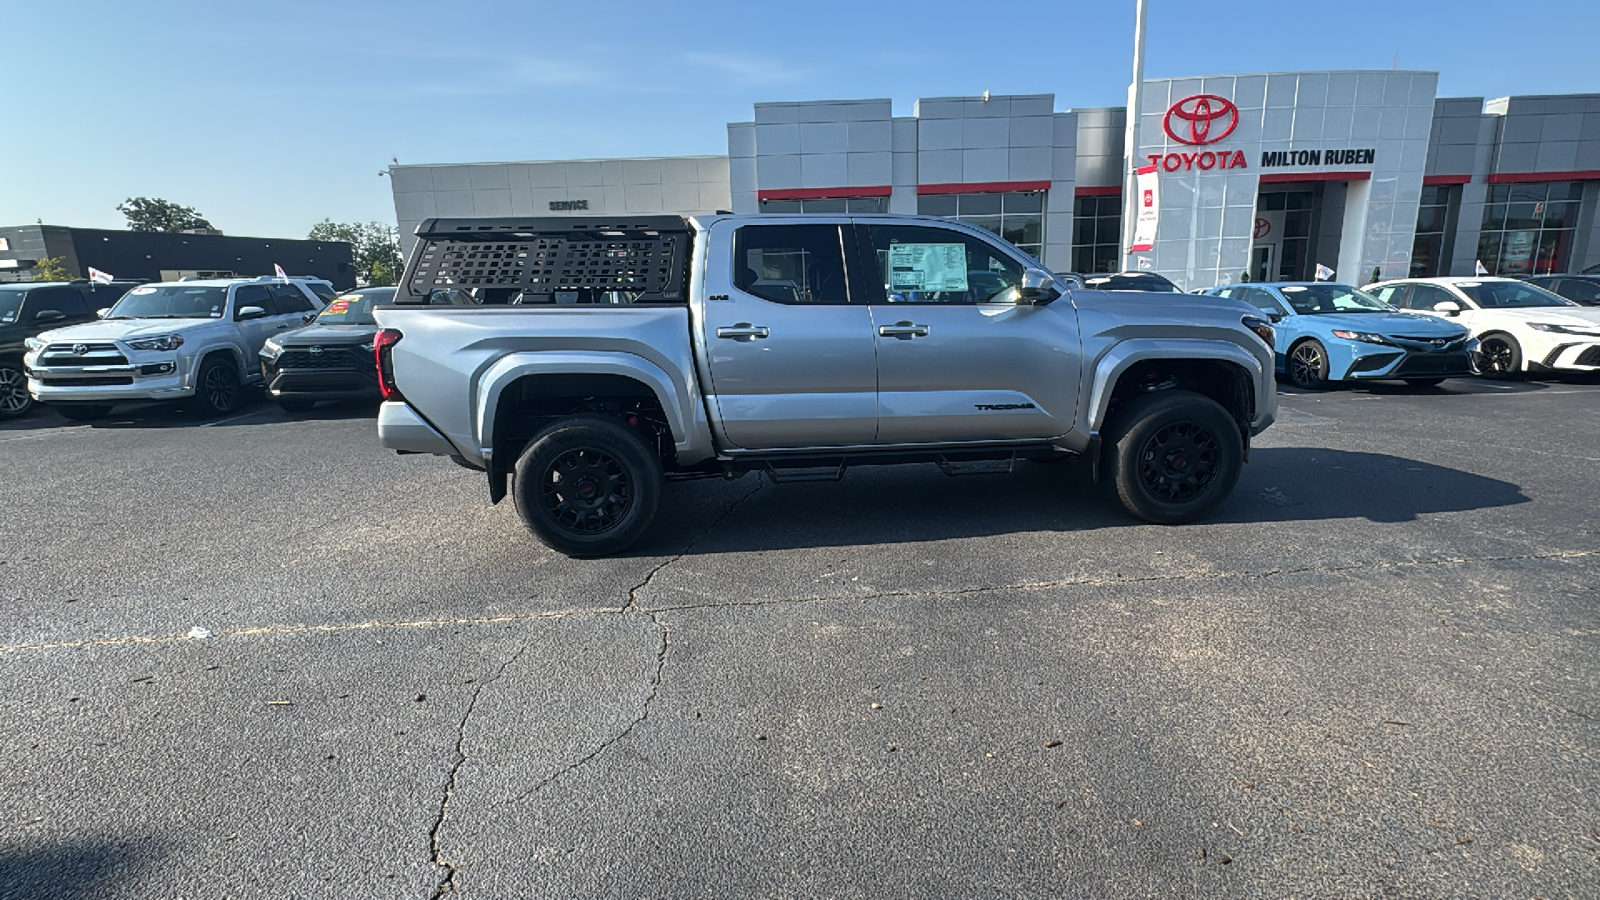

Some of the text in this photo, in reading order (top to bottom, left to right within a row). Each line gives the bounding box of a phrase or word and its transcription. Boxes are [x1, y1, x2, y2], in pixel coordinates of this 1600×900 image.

[1147, 150, 1247, 172] TOYOTA
[1261, 149, 1375, 167] MILTON RUBEN
[549, 200, 588, 211] SERVICE
